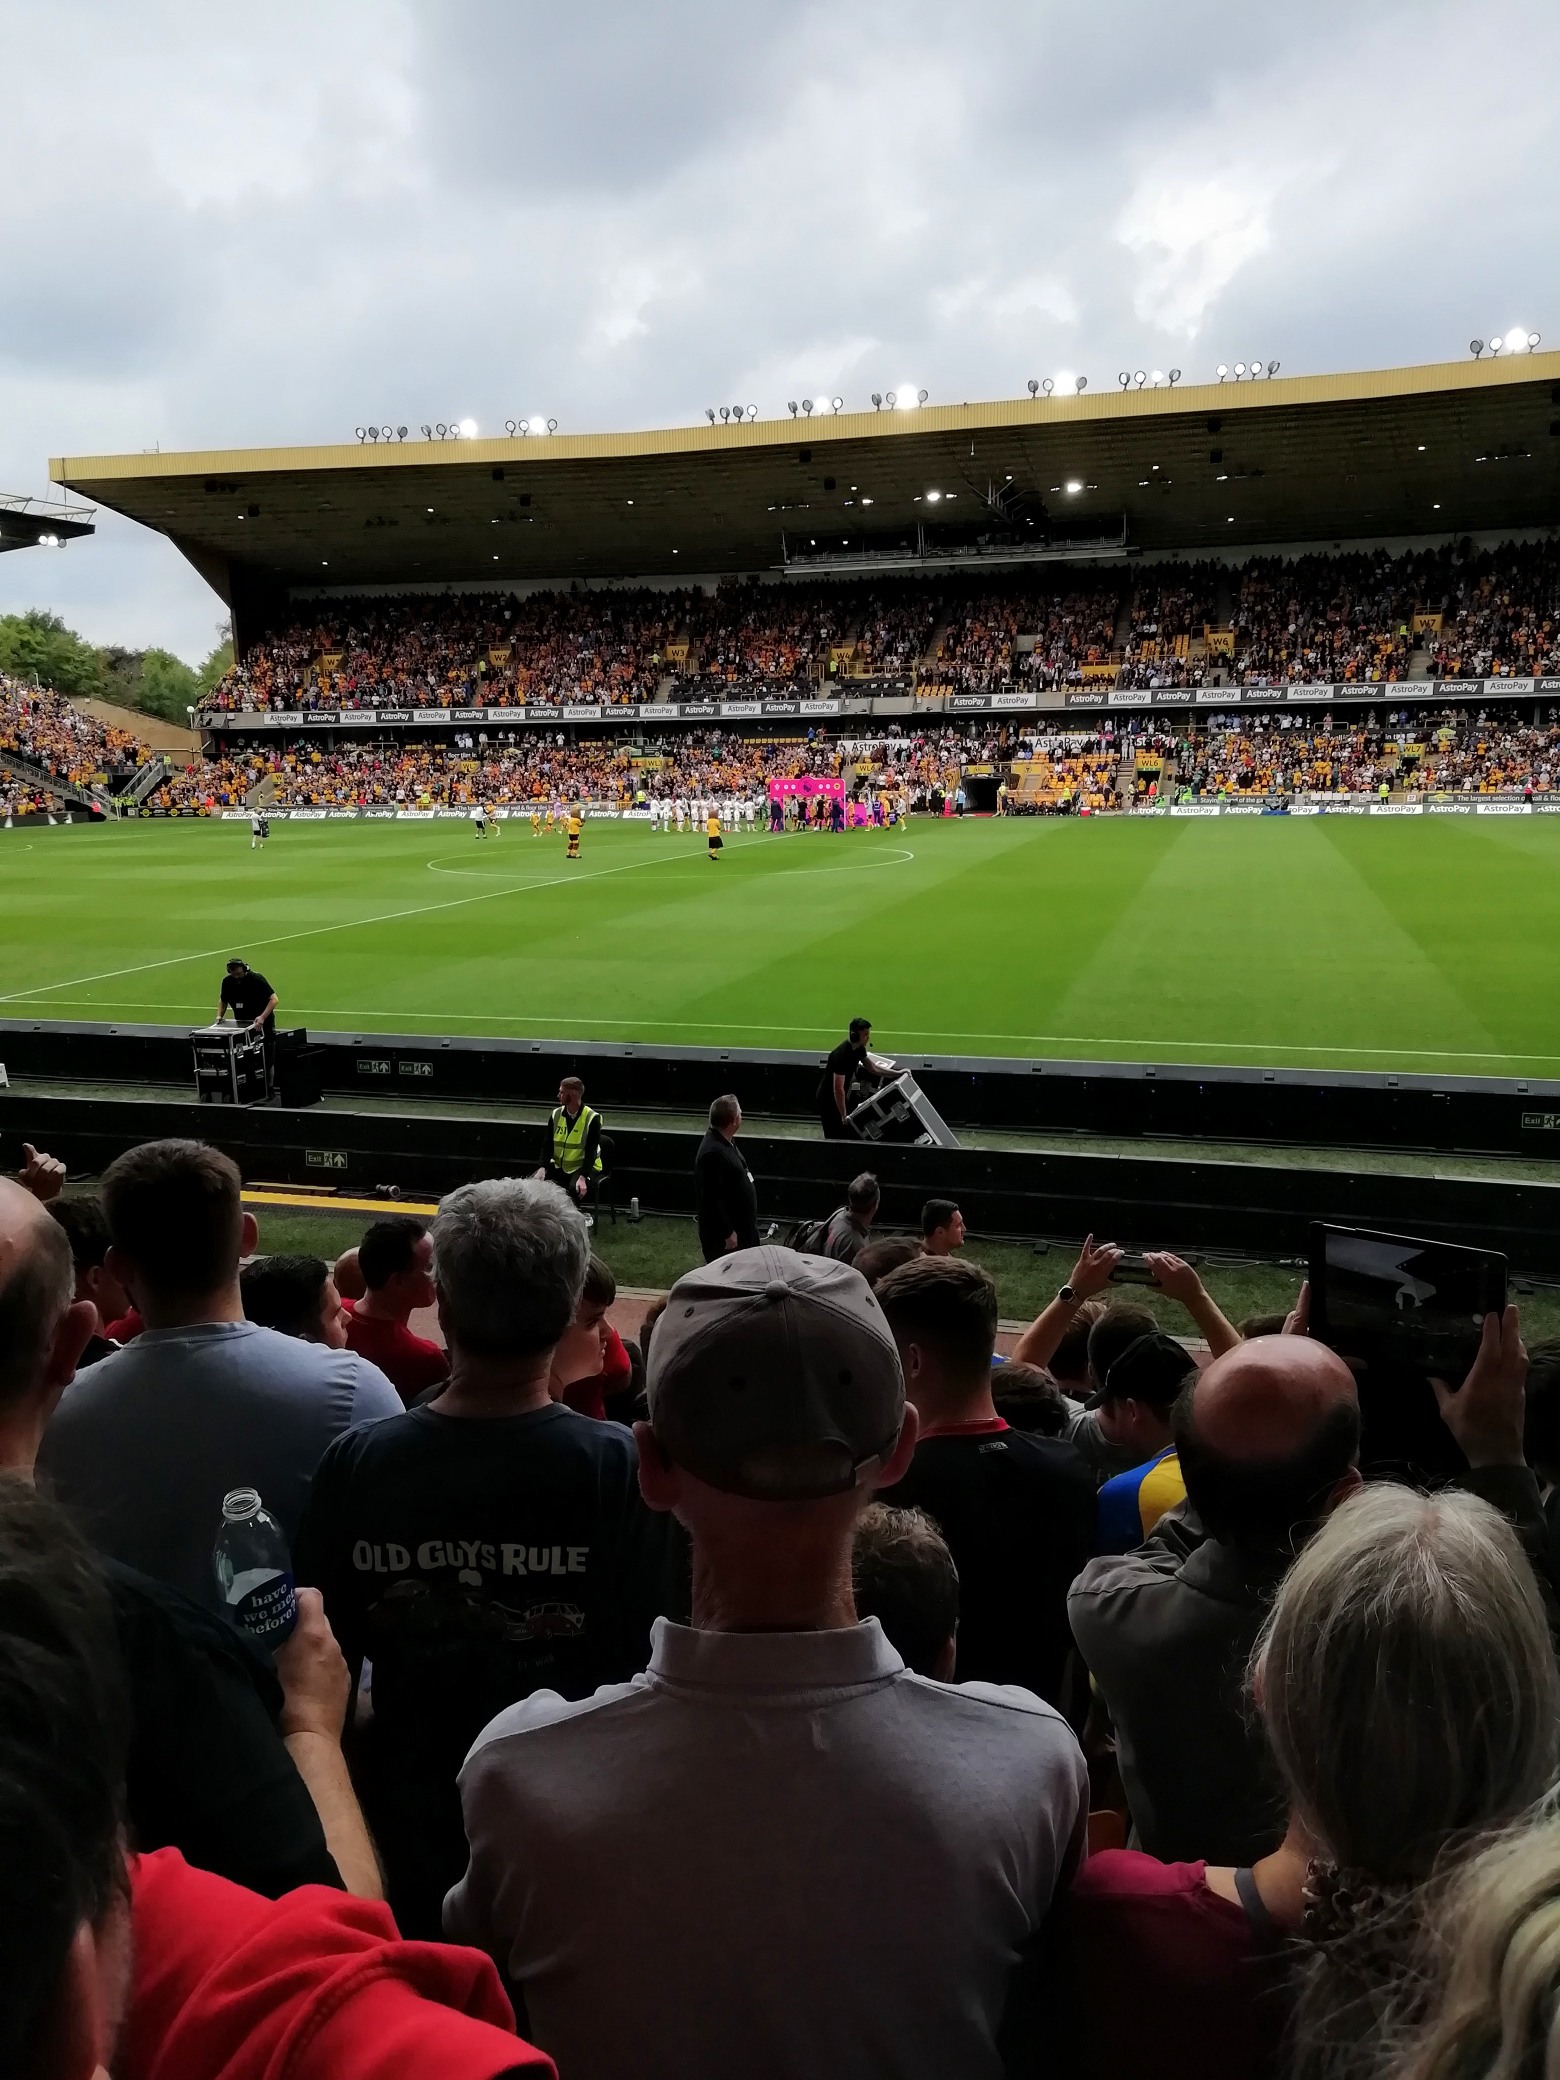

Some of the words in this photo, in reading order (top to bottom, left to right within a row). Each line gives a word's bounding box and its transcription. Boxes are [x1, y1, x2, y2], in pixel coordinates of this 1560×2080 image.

[1213, 637, 1229, 646] W6
[671, 649, 685, 657] W3
[836, 652, 850, 660] W4
[494, 654, 508, 662] W2
[1341, 685, 1378, 696] AstroPay
[1391, 684, 1428, 695] AstroPay
[1438, 682, 1478, 693] AstroPay
[1489, 681, 1529, 692] AstroPay
[1156, 691, 1191, 702] AstroPay
[1201, 690, 1236, 700] AstroPay
[1246, 688, 1283, 699] AstroPay
[1292, 687, 1328, 697] AstroPay
[953, 697, 986, 707] AstroPay
[996, 696, 1029, 706] AstroPay
[1070, 694, 1104, 704] AstroPay
[1113, 693, 1147, 703] AstroPay
[605, 706, 636, 717] AstroPay
[644, 706, 674, 716] AstroPay
[684, 705, 715, 715] AstroPay
[727, 704, 757, 713] AstroPay
[765, 703, 796, 713] AstroPay
[804, 702, 834, 712] AstroPay
[380, 711, 410, 721] AstroPay
[418, 711, 446, 721] AstroPay
[454, 710, 484, 720] AstroPay
[492, 710, 521, 719] AstroPay
[529, 709, 559, 718] AstroPay
[567, 708, 597, 717] AstroPay
[269, 714, 298, 723] AstroPay
[307, 713, 336, 723] AstroPay
[344, 713, 372, 722] AstroPay
[1035, 737, 1083, 749] AstoPay
[1142, 759, 1159, 767] WL6
[1129, 806, 1166, 815] AtroPay
[1177, 806, 1213, 815] AstroPay
[1225, 806, 1263, 815] AstroPay
[1325, 805, 1365, 814] AstroPay
[1376, 804, 1417, 813] AstroPay
[1429, 805, 1470, 814] AstroPay
[1483, 804, 1525, 813] AstroPay
[260, 811, 288, 819] AstroPay
[329, 811, 358, 819] AstroPay
[401, 810, 430, 818] AstroPay
[437, 810, 467, 818] AstroPay
[512, 810, 542, 818] AstroPy
[588, 810, 619, 819] AstroPay
[1524, 1116, 1541, 1125] Exit
[308, 1154, 321, 1163] Exit
[352, 1539, 411, 1573] OLD
[417, 1539, 497, 1571] GUYS
[500, 1543, 590, 1575] RULE
[251, 1583, 287, 1608] have
[243, 1610, 267, 1622] we
